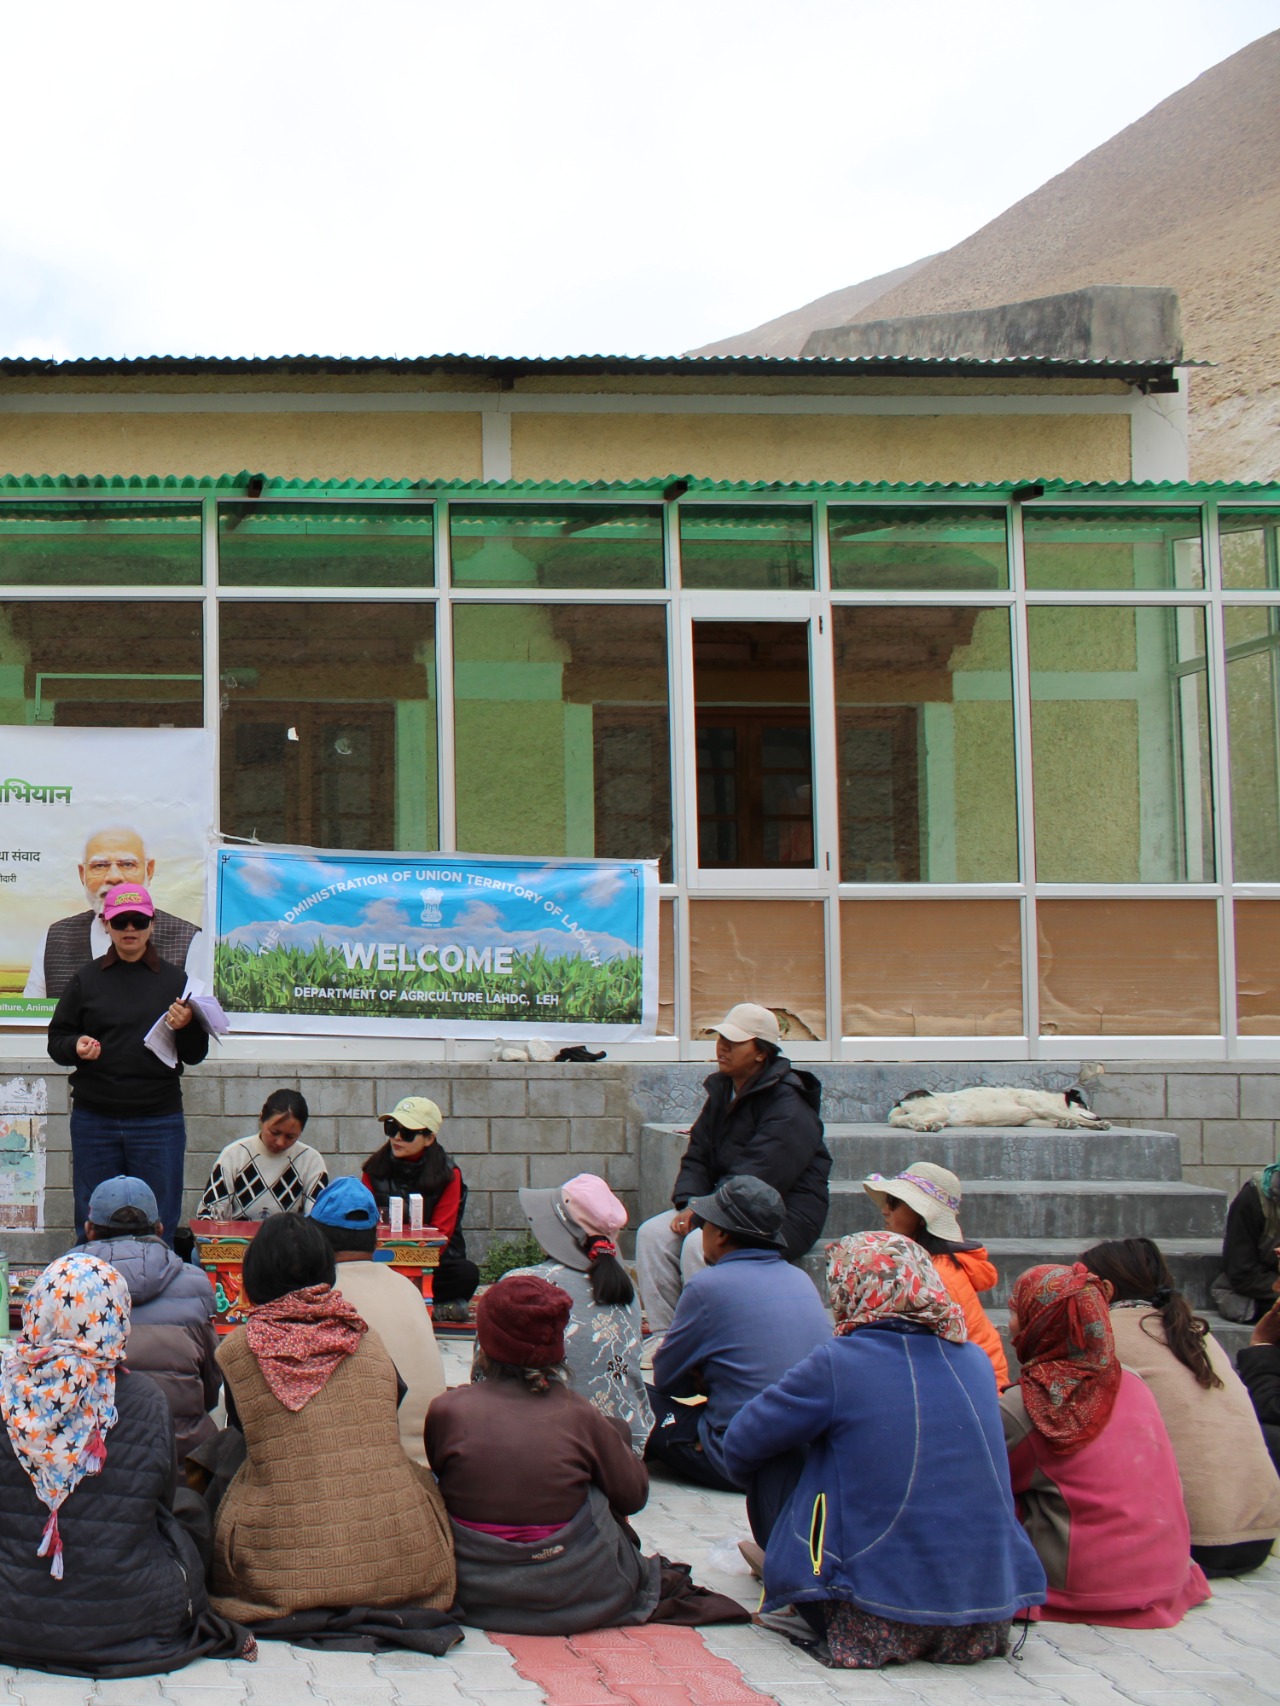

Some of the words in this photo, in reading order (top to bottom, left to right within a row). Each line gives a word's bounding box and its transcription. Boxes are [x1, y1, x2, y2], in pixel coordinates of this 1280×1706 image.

[12, 849, 41, 862] संवाद
[258, 928, 280, 957] THE
[277, 872, 388, 930] ADMINISTRATION
[392, 870, 412, 882] OF
[416, 870, 462, 883] UNION
[466, 873, 543, 905] TERRITORY
[544, 900, 564, 916] OF
[561, 914, 602, 969] LADAKH
[341, 942, 514, 974] WELCOME
[294, 986, 376, 1000] DEPARTMENT
[380, 988, 397, 1000] OF
[399, 990, 483, 1003] AGRICULTURE
[486, 992, 530, 1006] LAHDC,
[536, 994, 560, 1006] LEH
[26, 1003, 56, 1012] Animal
